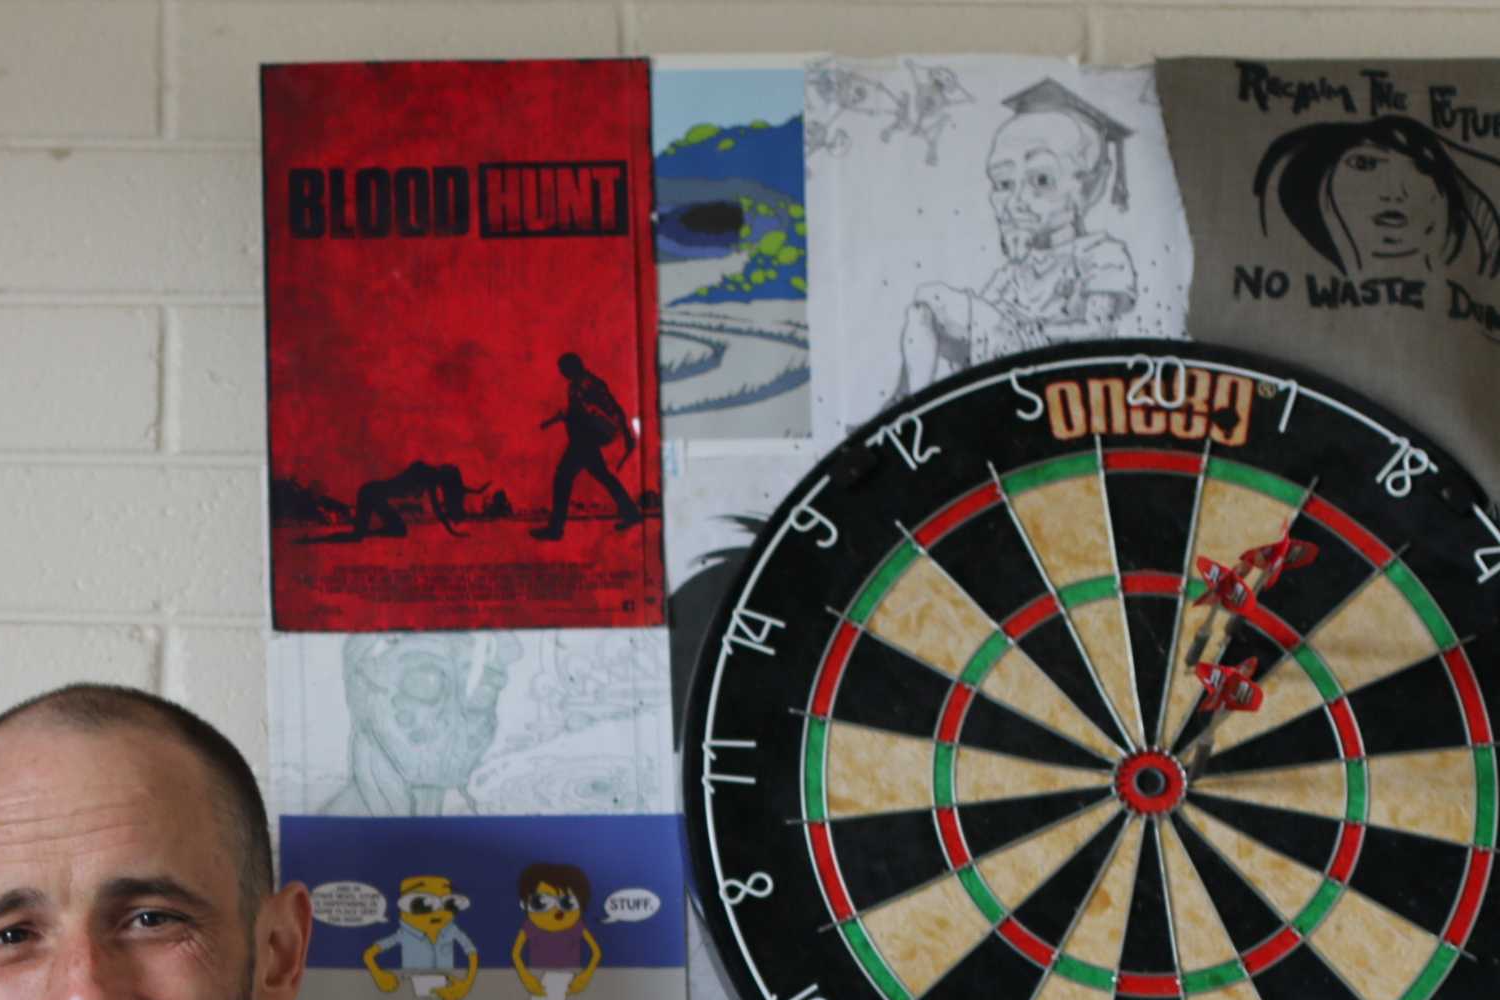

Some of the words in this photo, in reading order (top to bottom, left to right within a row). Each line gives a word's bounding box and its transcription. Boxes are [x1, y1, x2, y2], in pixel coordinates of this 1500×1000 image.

[1359, 68, 1408, 117] THE
[1428, 85, 1500, 142] FUTU
[287, 165, 470, 240] BLOOD
[485, 165, 622, 234] HUNT
[1233, 266, 1290, 300] NO
[1305, 273, 1427, 311] WASTE
[1010, 366, 1044, 421] 5
[1126, 352, 1187, 410] 20
[1278, 378, 1299, 434] 1
[873, 412, 942, 470] 12
[1374, 436, 1430, 498] 18
[791, 502, 839, 548] 9
[722, 606, 786, 656] 14
[702, 738, 758, 794] 11
[720, 870, 774, 907] 8
